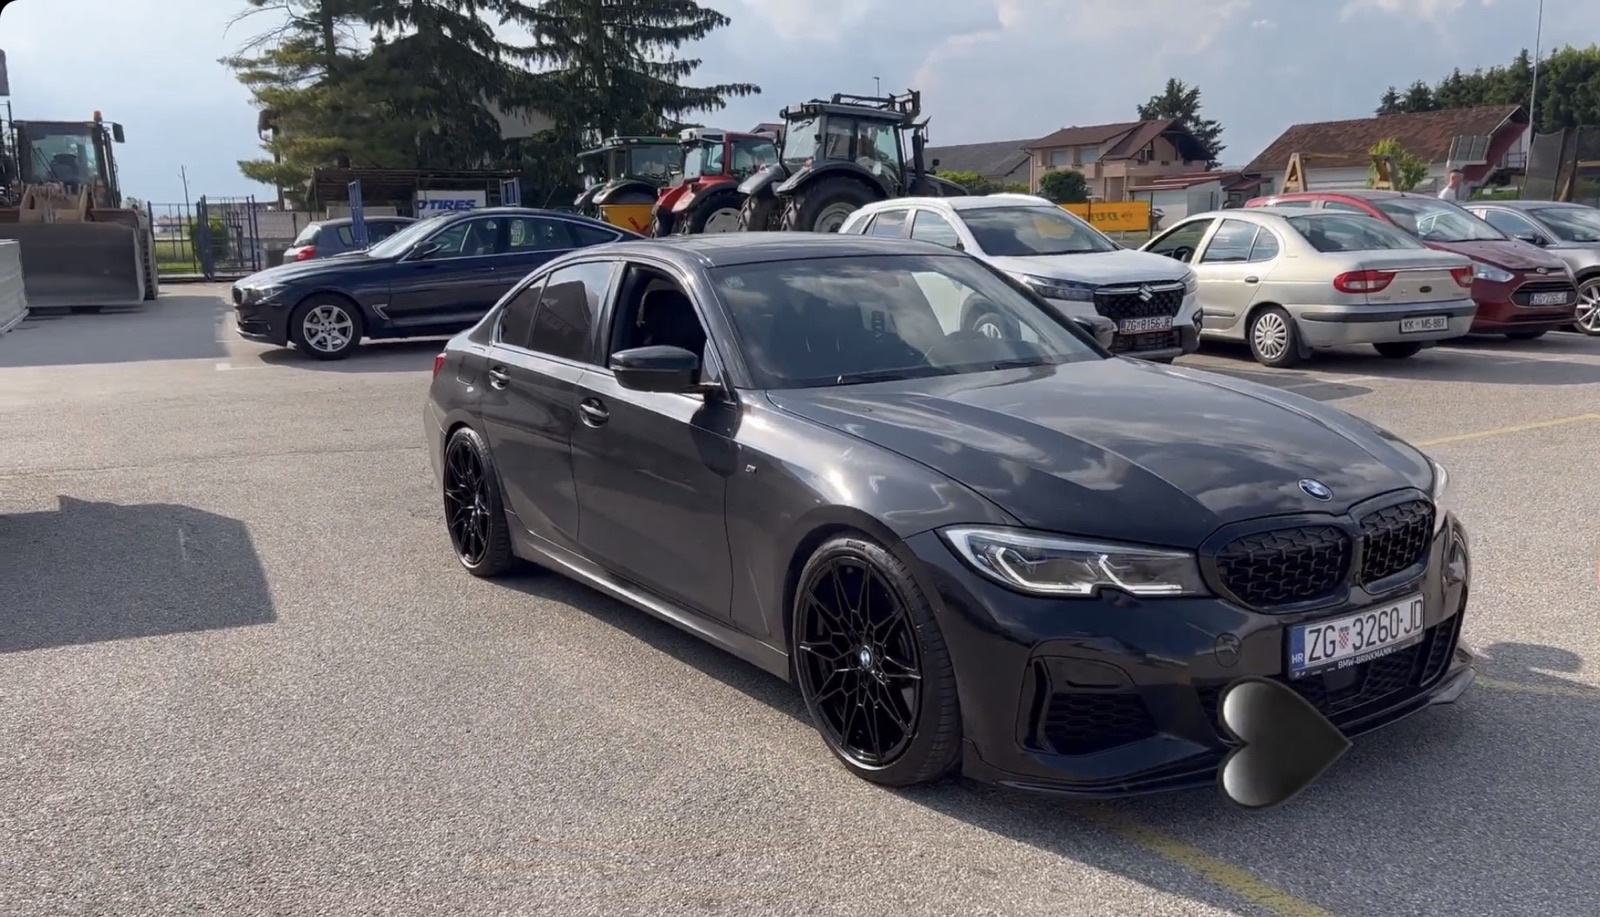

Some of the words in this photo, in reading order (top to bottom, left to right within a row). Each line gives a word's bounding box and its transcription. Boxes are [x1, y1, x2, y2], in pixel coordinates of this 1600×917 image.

[430, 199, 476, 211] TIRES
[1308, 625, 1337, 662] ZG
[1291, 653, 1304, 664] HR
